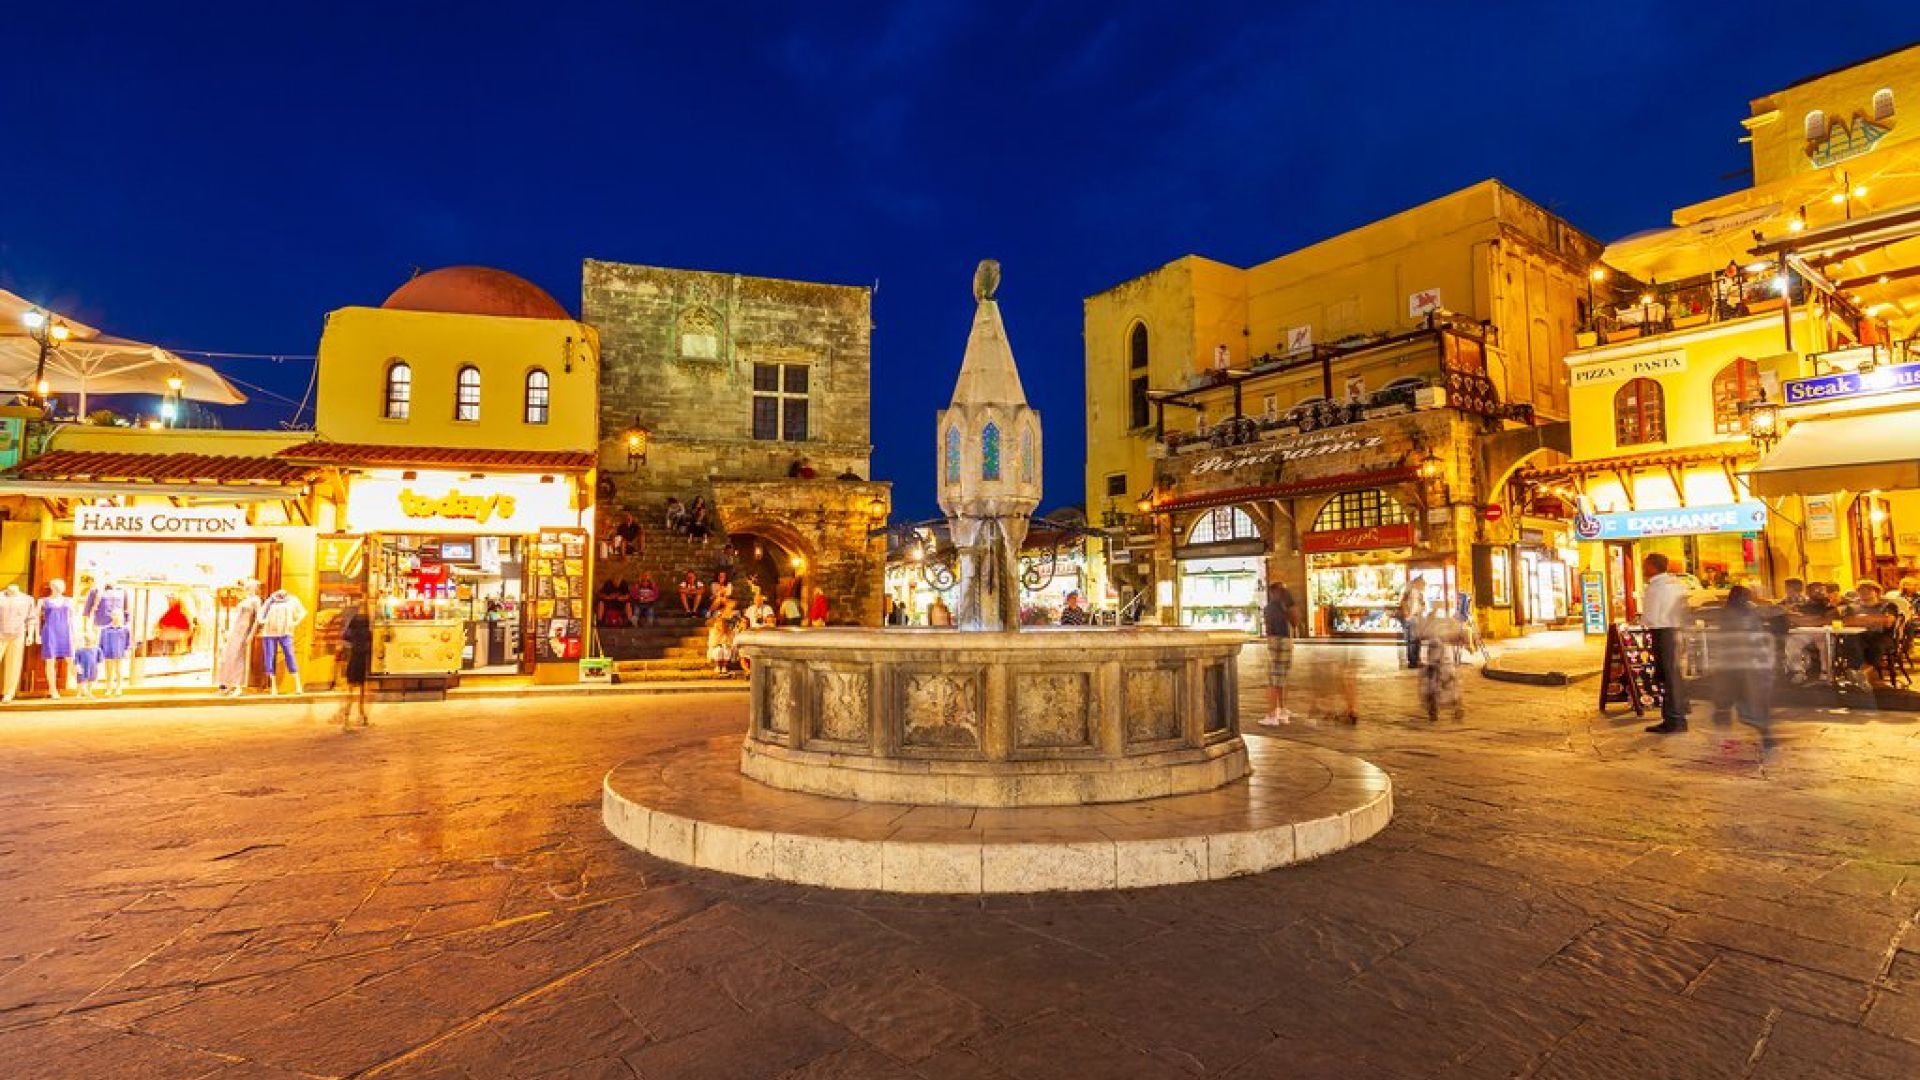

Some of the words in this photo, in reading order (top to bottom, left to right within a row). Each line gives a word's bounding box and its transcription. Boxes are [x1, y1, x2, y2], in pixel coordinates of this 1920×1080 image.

[1576, 368, 1615, 380] PIZZA
[1633, 358, 1681, 372] PASTA
[1792, 377, 1854, 399] Steak
[398, 488, 516, 524] today's
[83, 513, 143, 531] HARIS
[151, 514, 236, 532] COTTON
[1627, 510, 1738, 531] EXCHANGE
